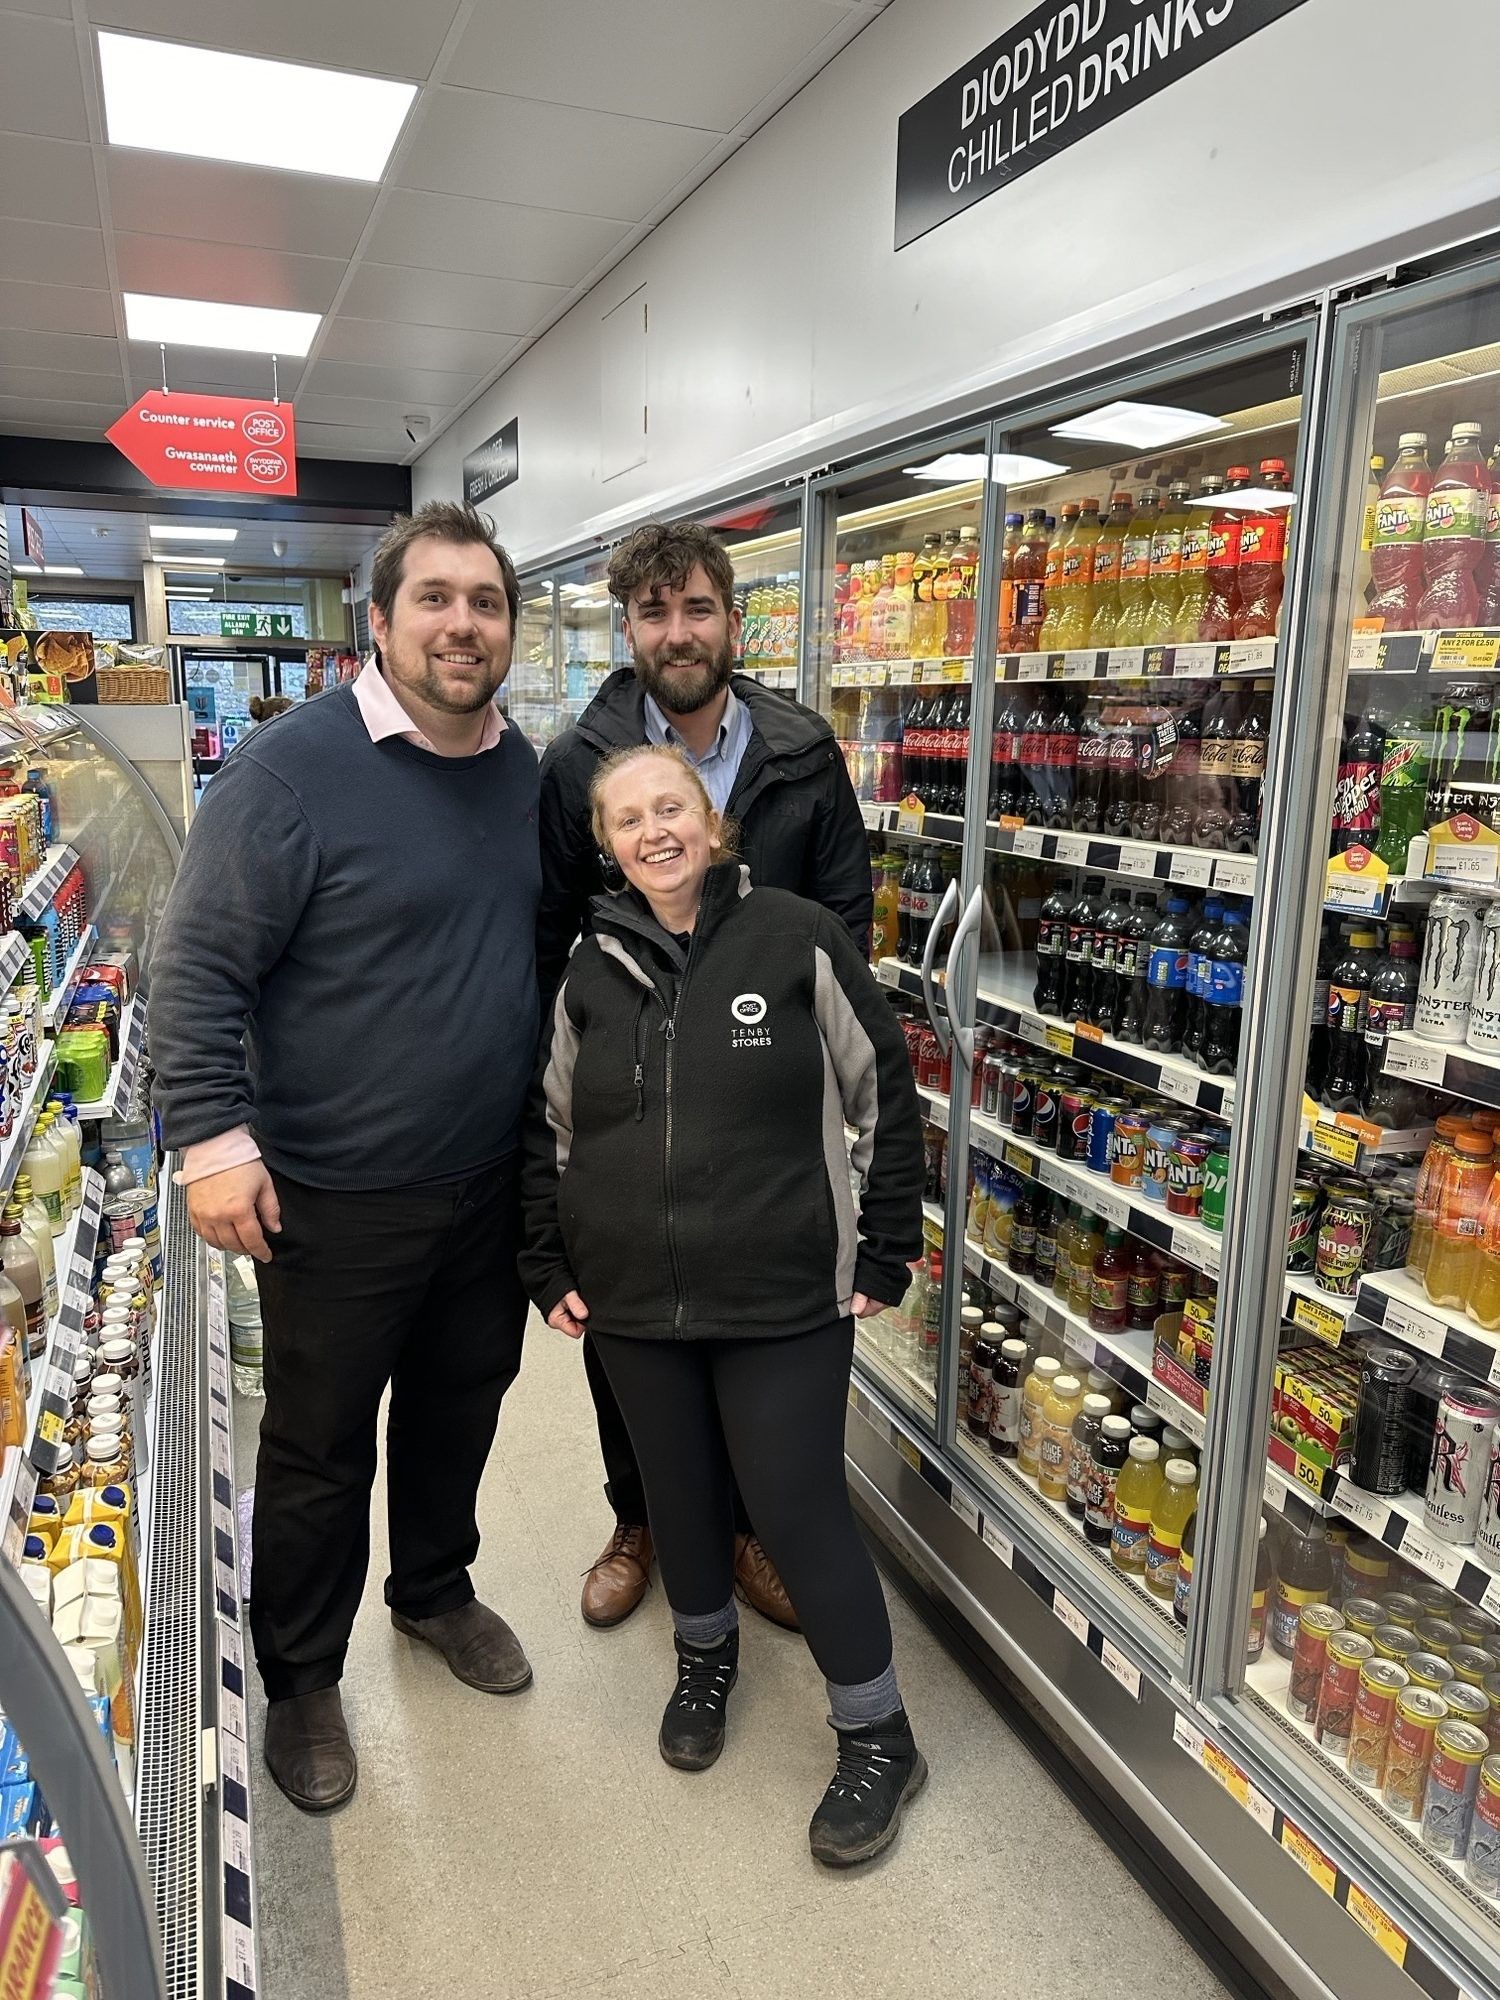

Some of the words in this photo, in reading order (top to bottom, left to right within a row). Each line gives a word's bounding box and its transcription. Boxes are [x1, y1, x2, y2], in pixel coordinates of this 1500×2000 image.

[961, 0, 1107, 130] DIODYDD
[948, 73, 1073, 193] CHILLED
[139, 409, 191, 427] Counter
[193, 415, 236, 430] service
[252, 418, 277, 429] POST
[247, 427, 280, 438] OFFICE
[165, 446, 237, 463] Gwasanaeth
[189, 462, 237, 474] cownter
[251, 464, 281, 476] POST
[224, 621, 250, 629] ALLANFA
[1147, 651, 1163, 662] MEAL
[1147, 662, 1162, 673] DEAL
[1458, 861, 1480, 871] £1.65
[1420, 1017, 1445, 1026] ULTRA
[731, 1027, 770, 1038] TENBY
[1077, 1027, 1089, 1039] Sugar
[1473, 1030, 1498, 1040] ULTRA
[731, 1037, 772, 1048] STORES
[1409, 1059, 1429, 1071] £1.55
[1085, 1111, 1094, 1158] pepsi
[1339, 1121, 1359, 1135] Sugar
[1360, 1128, 1376, 1141] Free
[1335, 1259, 1357, 1269] PUNCH
[1318, 1310, 1329, 1321] FOR
[1405, 1322, 1427, 1340] £1.25
[1166, 1371, 1181, 1387] Juice
[1181, 1383, 1199, 1402] Drink
[1292, 1384, 1306, 1402] 50p
[1318, 1406, 1333, 1425] 50p
[1299, 1462, 1320, 1488] 50p
[1354, 1503, 1373, 1521] £1.19
[1424, 1550, 1446, 1570] £1.19
[1453, 1710, 1469, 1723] 35p
[1295, 1838, 1311, 1857] ONLY
[1362, 1900, 1380, 1920] ONLY
[1379, 1917, 1393, 1934] 35P
